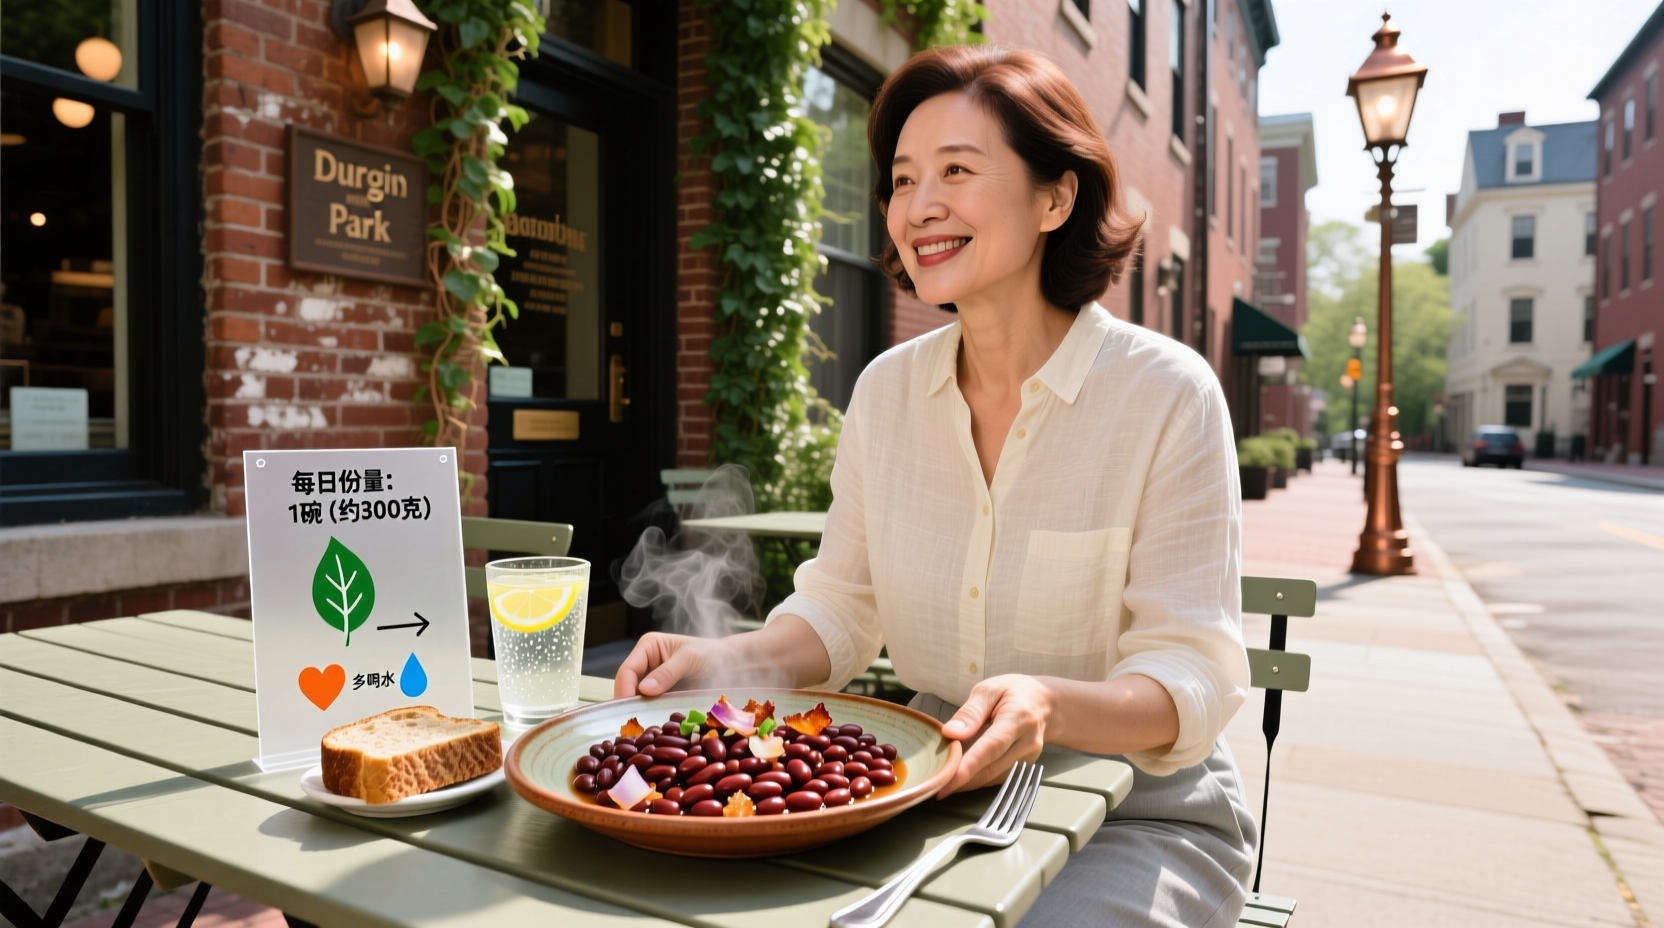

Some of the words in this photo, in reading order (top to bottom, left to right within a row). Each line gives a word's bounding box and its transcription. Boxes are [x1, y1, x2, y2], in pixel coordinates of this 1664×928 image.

[314, 149, 408, 203] Durgin
[329, 202, 391, 243] Park
[291, 469, 393, 495] 每日份量：
